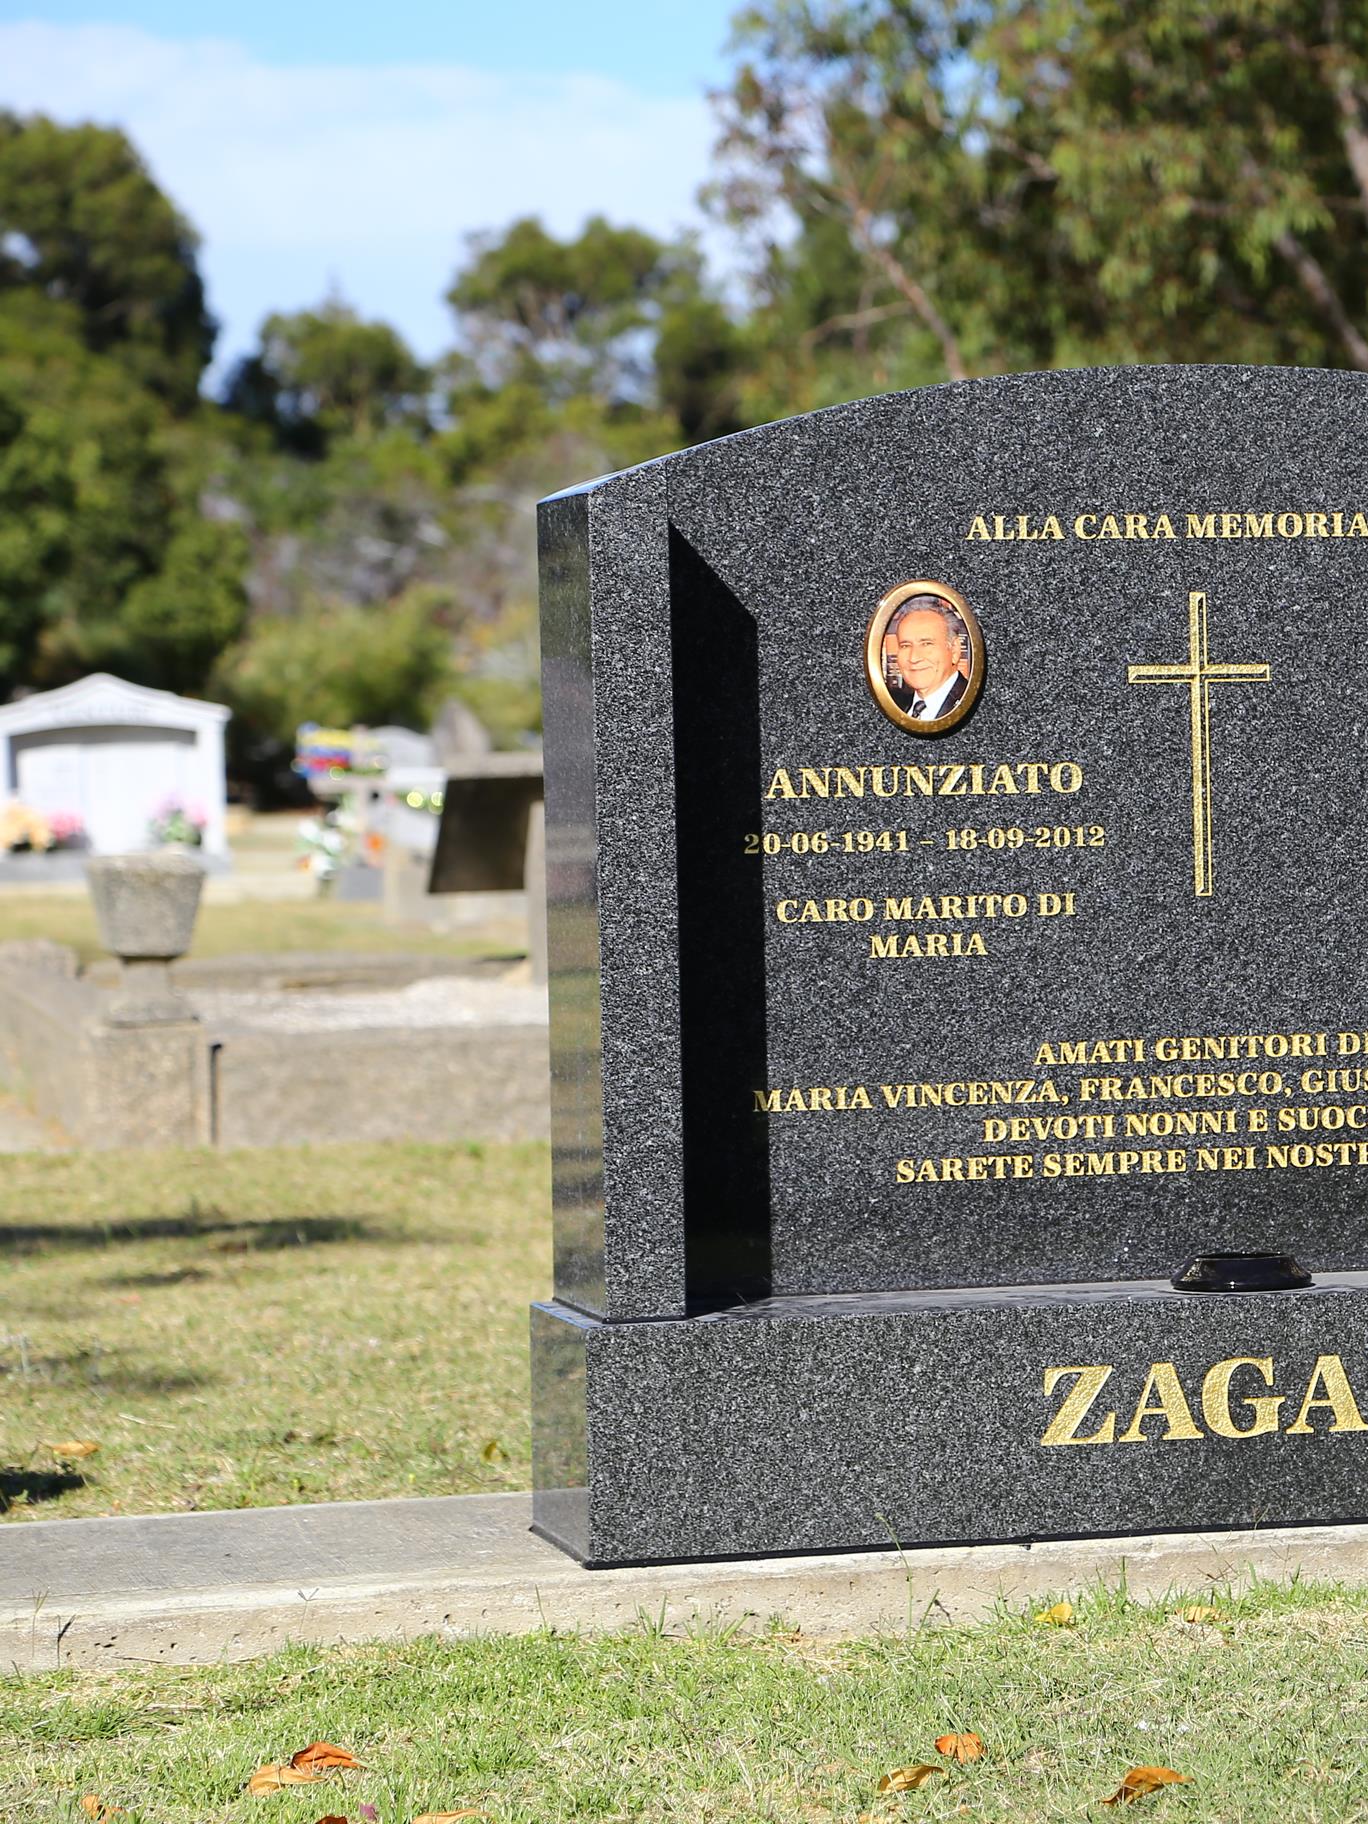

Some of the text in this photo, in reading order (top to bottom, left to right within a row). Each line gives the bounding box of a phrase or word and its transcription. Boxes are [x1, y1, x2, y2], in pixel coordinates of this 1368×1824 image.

[966, 514, 1065, 541] ALLA
[1073, 513, 1177, 540] CARA
[764, 761, 1084, 799] ANNUNZIATO
[744, 832, 909, 854] 20-06-1941
[946, 826, 1106, 850] 18-09-2012
[776, 891, 1076, 923] CARO MARITO DI
[869, 932, 988, 958] MARIA
[1034, 1038, 1146, 1066] AMATI
[1154, 1031, 1328, 1062] GENITORI
[753, 1085, 874, 1113] MARIA
[880, 1078, 1070, 1107] VINCENZA,
[1078, 1071, 1293, 1101] FRANCESCO,
[982, 1112, 1116, 1143] DEVOTI
[1124, 1109, 1239, 1138] NONNI
[1247, 1108, 1269, 1133] E
[896, 1154, 1034, 1184] SARETE
[1043, 1148, 1188, 1178] SEMPRE
[1196, 1145, 1257, 1172] NEI
